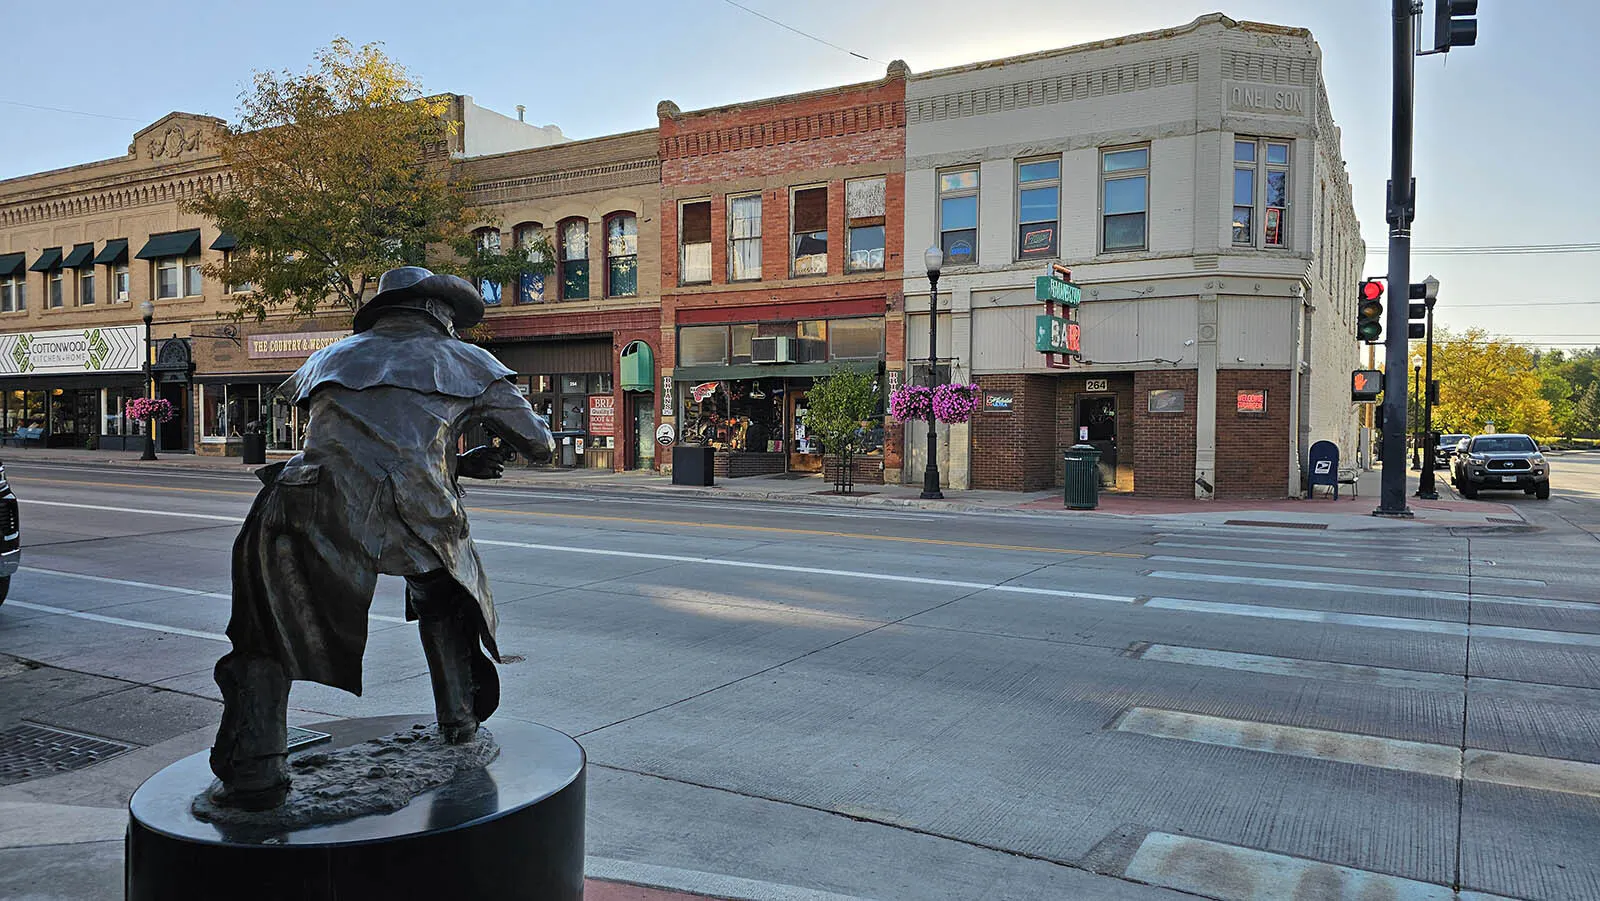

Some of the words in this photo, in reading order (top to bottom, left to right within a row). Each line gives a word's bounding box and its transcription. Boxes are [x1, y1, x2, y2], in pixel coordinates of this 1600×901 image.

[1051, 319, 1081, 352] BAR
[31, 341, 87, 354] COTTONWOOD
[253, 340, 268, 353] THE
[270, 339, 301, 352] COUNTRY
[302, 338, 308, 351] &
[32, 354, 61, 363] KITCHEN
[66, 353, 87, 361] HOME
[1087, 380, 1106, 390] 264
[1237, 394, 1263, 402] WELCOME
